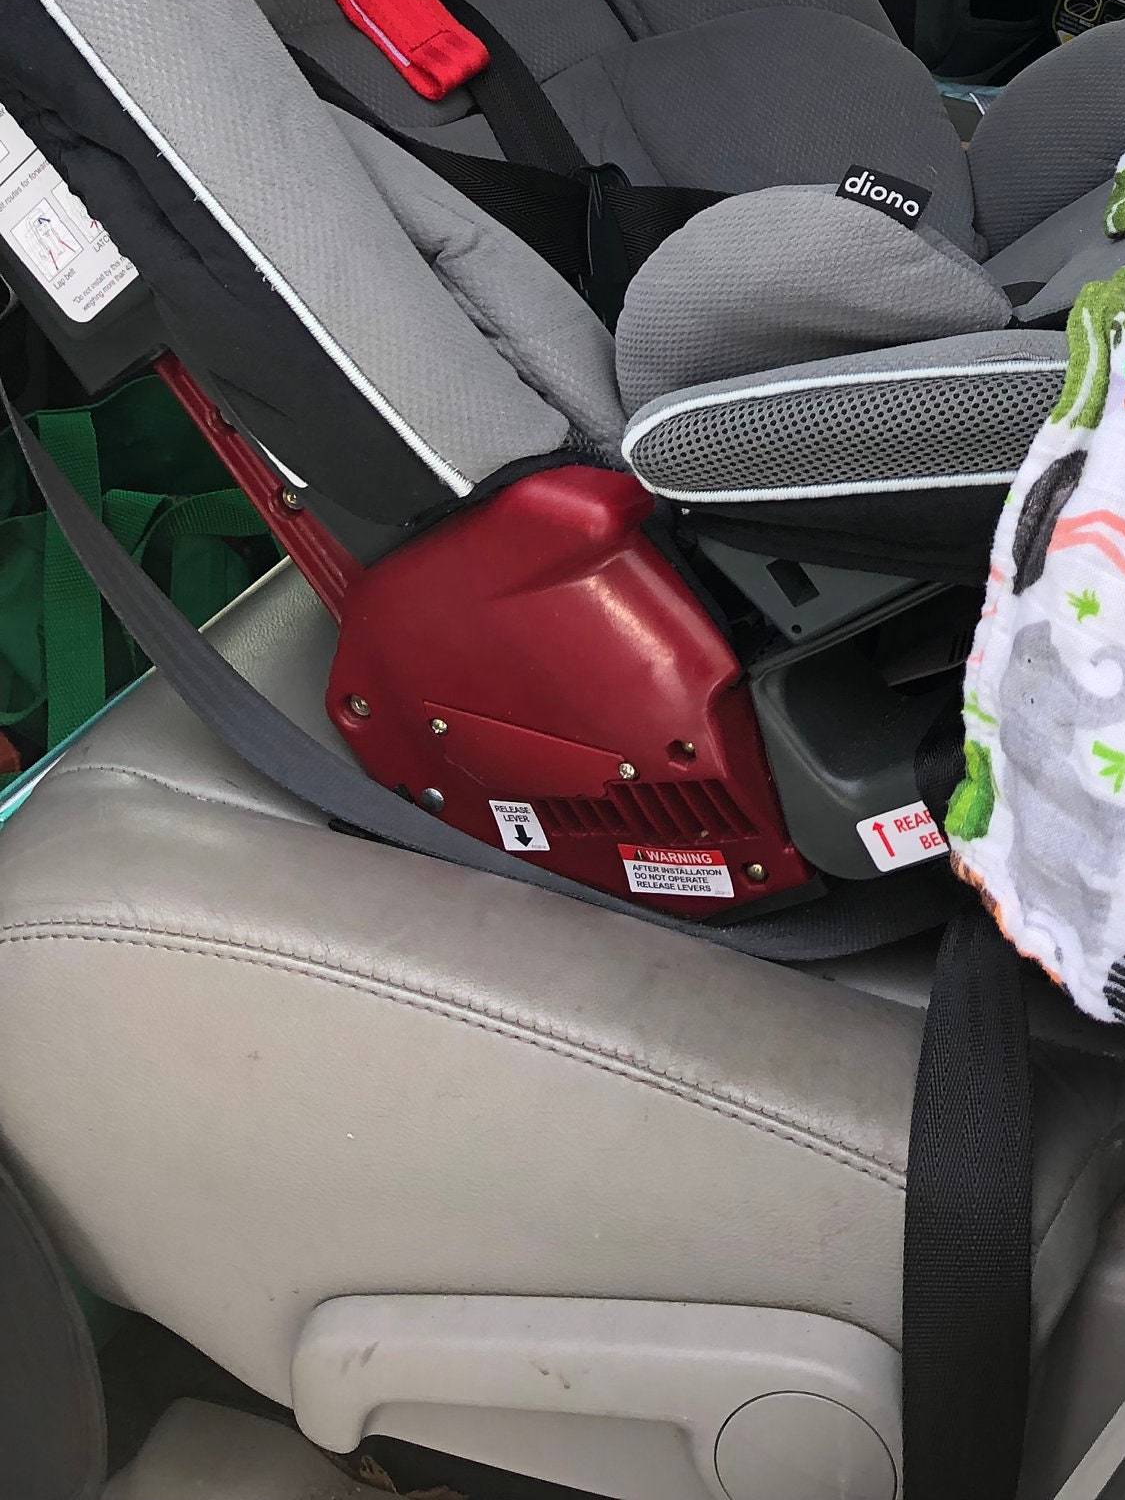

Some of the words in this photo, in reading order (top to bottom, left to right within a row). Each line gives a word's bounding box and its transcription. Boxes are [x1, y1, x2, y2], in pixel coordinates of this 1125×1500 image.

[844, 171, 920, 217] diono
[93, 234, 110, 253] LATC
[53, 280, 66, 290] Lap
[494, 804, 531, 814] RELEASE
[503, 814, 531, 823] LEVER
[645, 849, 713, 864] WARNING
[632, 864, 660, 873] AFTER
[661, 866, 722, 876] INSTALLATION
[634, 872, 648, 880] DO
[649, 873, 667, 882] NOT
[668, 875, 709, 884] OPERATE
[636, 880, 676, 890] RELEASE
[677, 883, 712, 892] LEVERS
